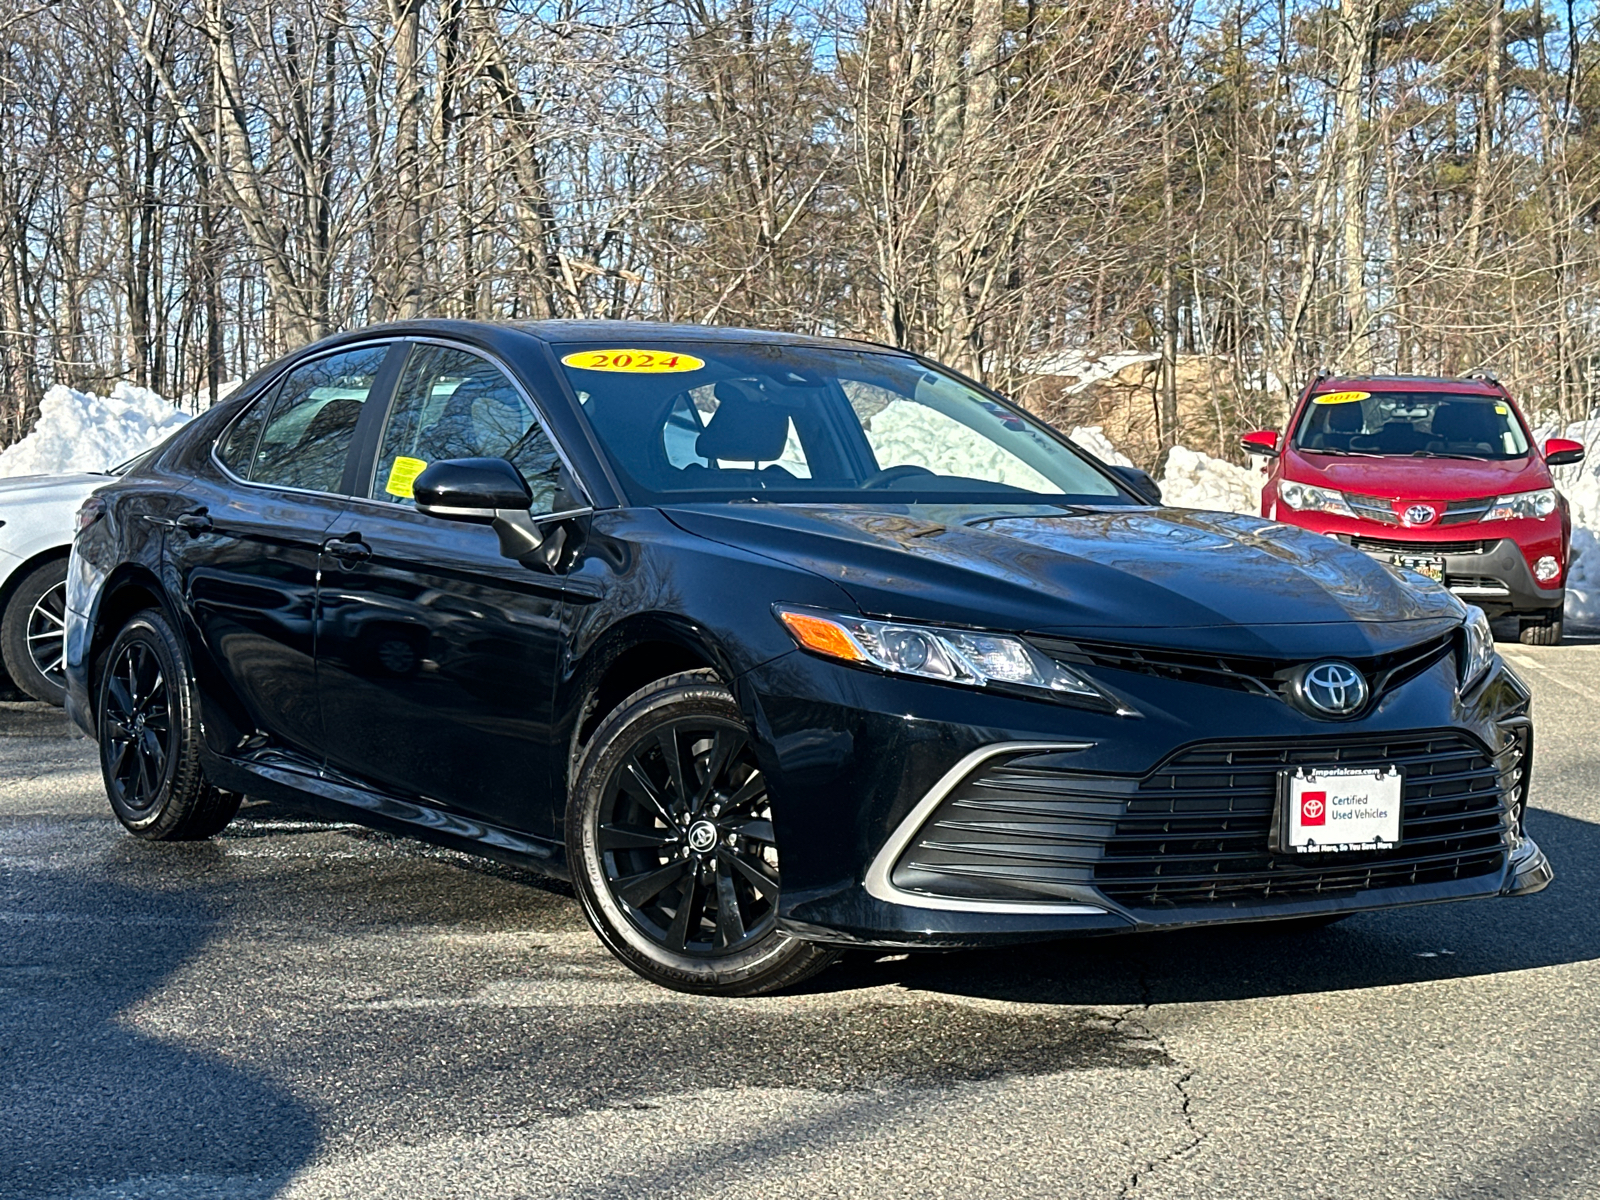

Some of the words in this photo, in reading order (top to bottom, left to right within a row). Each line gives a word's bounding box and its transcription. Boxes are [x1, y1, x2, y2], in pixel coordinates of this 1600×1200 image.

[590, 354, 679, 368] 2024
[1324, 393, 1360, 402] 2014
[1332, 794, 1368, 806] Certified
[1332, 809, 1353, 820] Used
[1354, 808, 1388, 819] Vehicles
